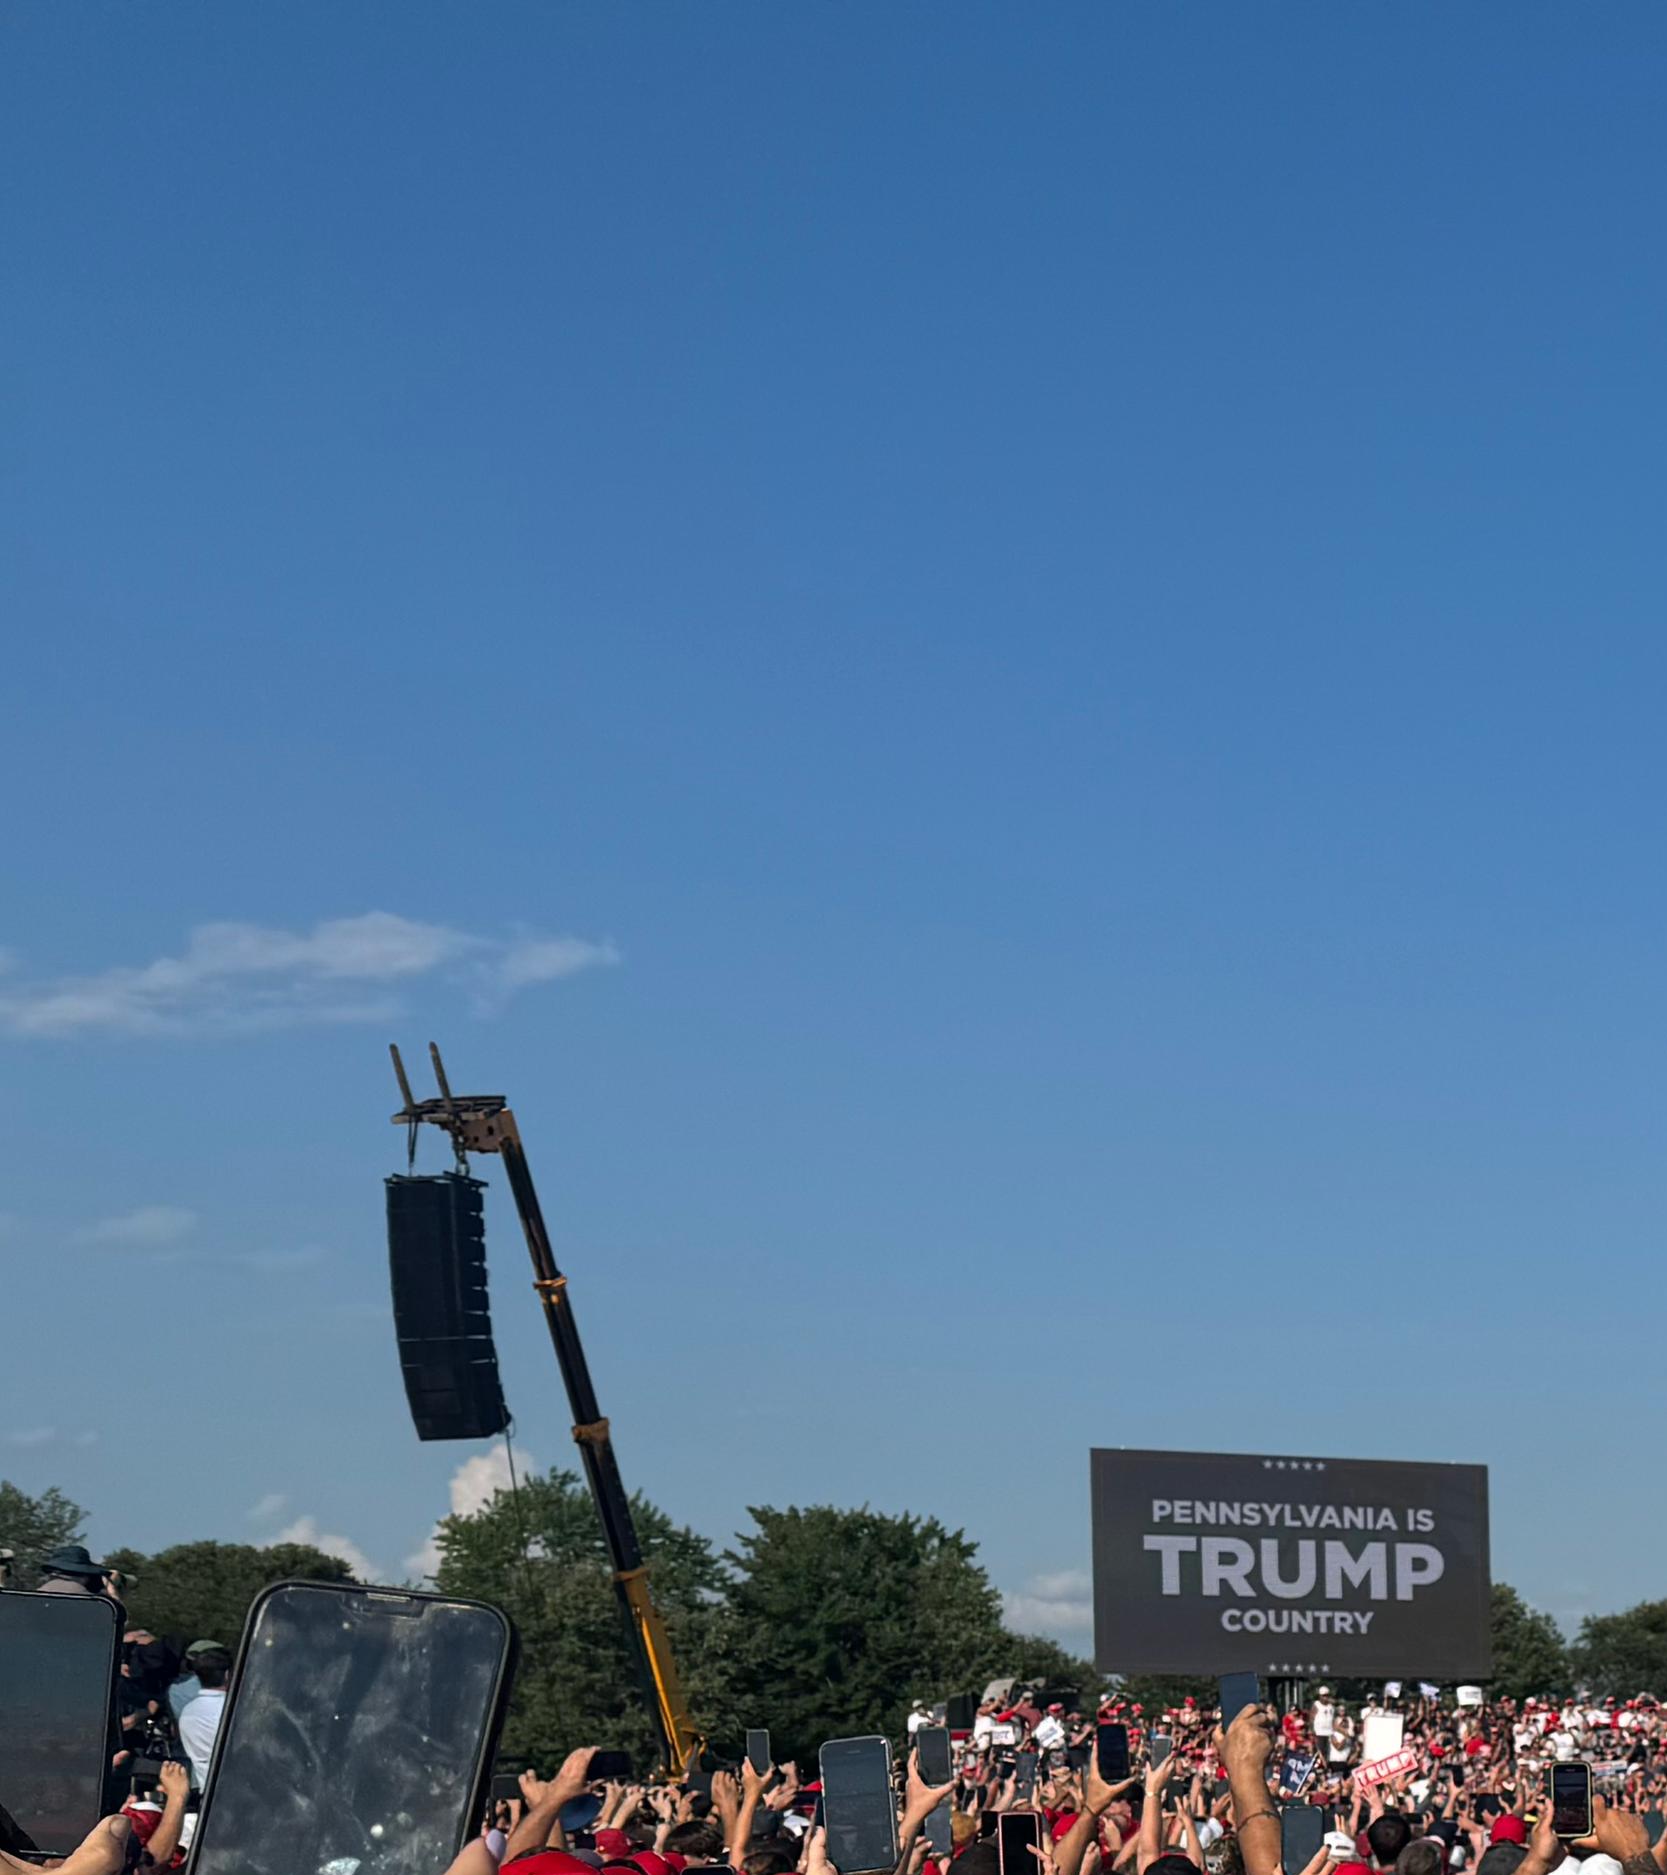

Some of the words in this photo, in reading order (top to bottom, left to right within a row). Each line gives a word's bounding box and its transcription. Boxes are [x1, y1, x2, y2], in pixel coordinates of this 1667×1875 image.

[1152, 1499, 1398, 1531] PENNSYLVANIA
[1408, 1509, 1435, 1532] IS
[1143, 1535, 1445, 1600] TRUMP
[1221, 1608, 1374, 1635] COUNTRY
[1356, 1752, 1410, 1787] TRUMP
